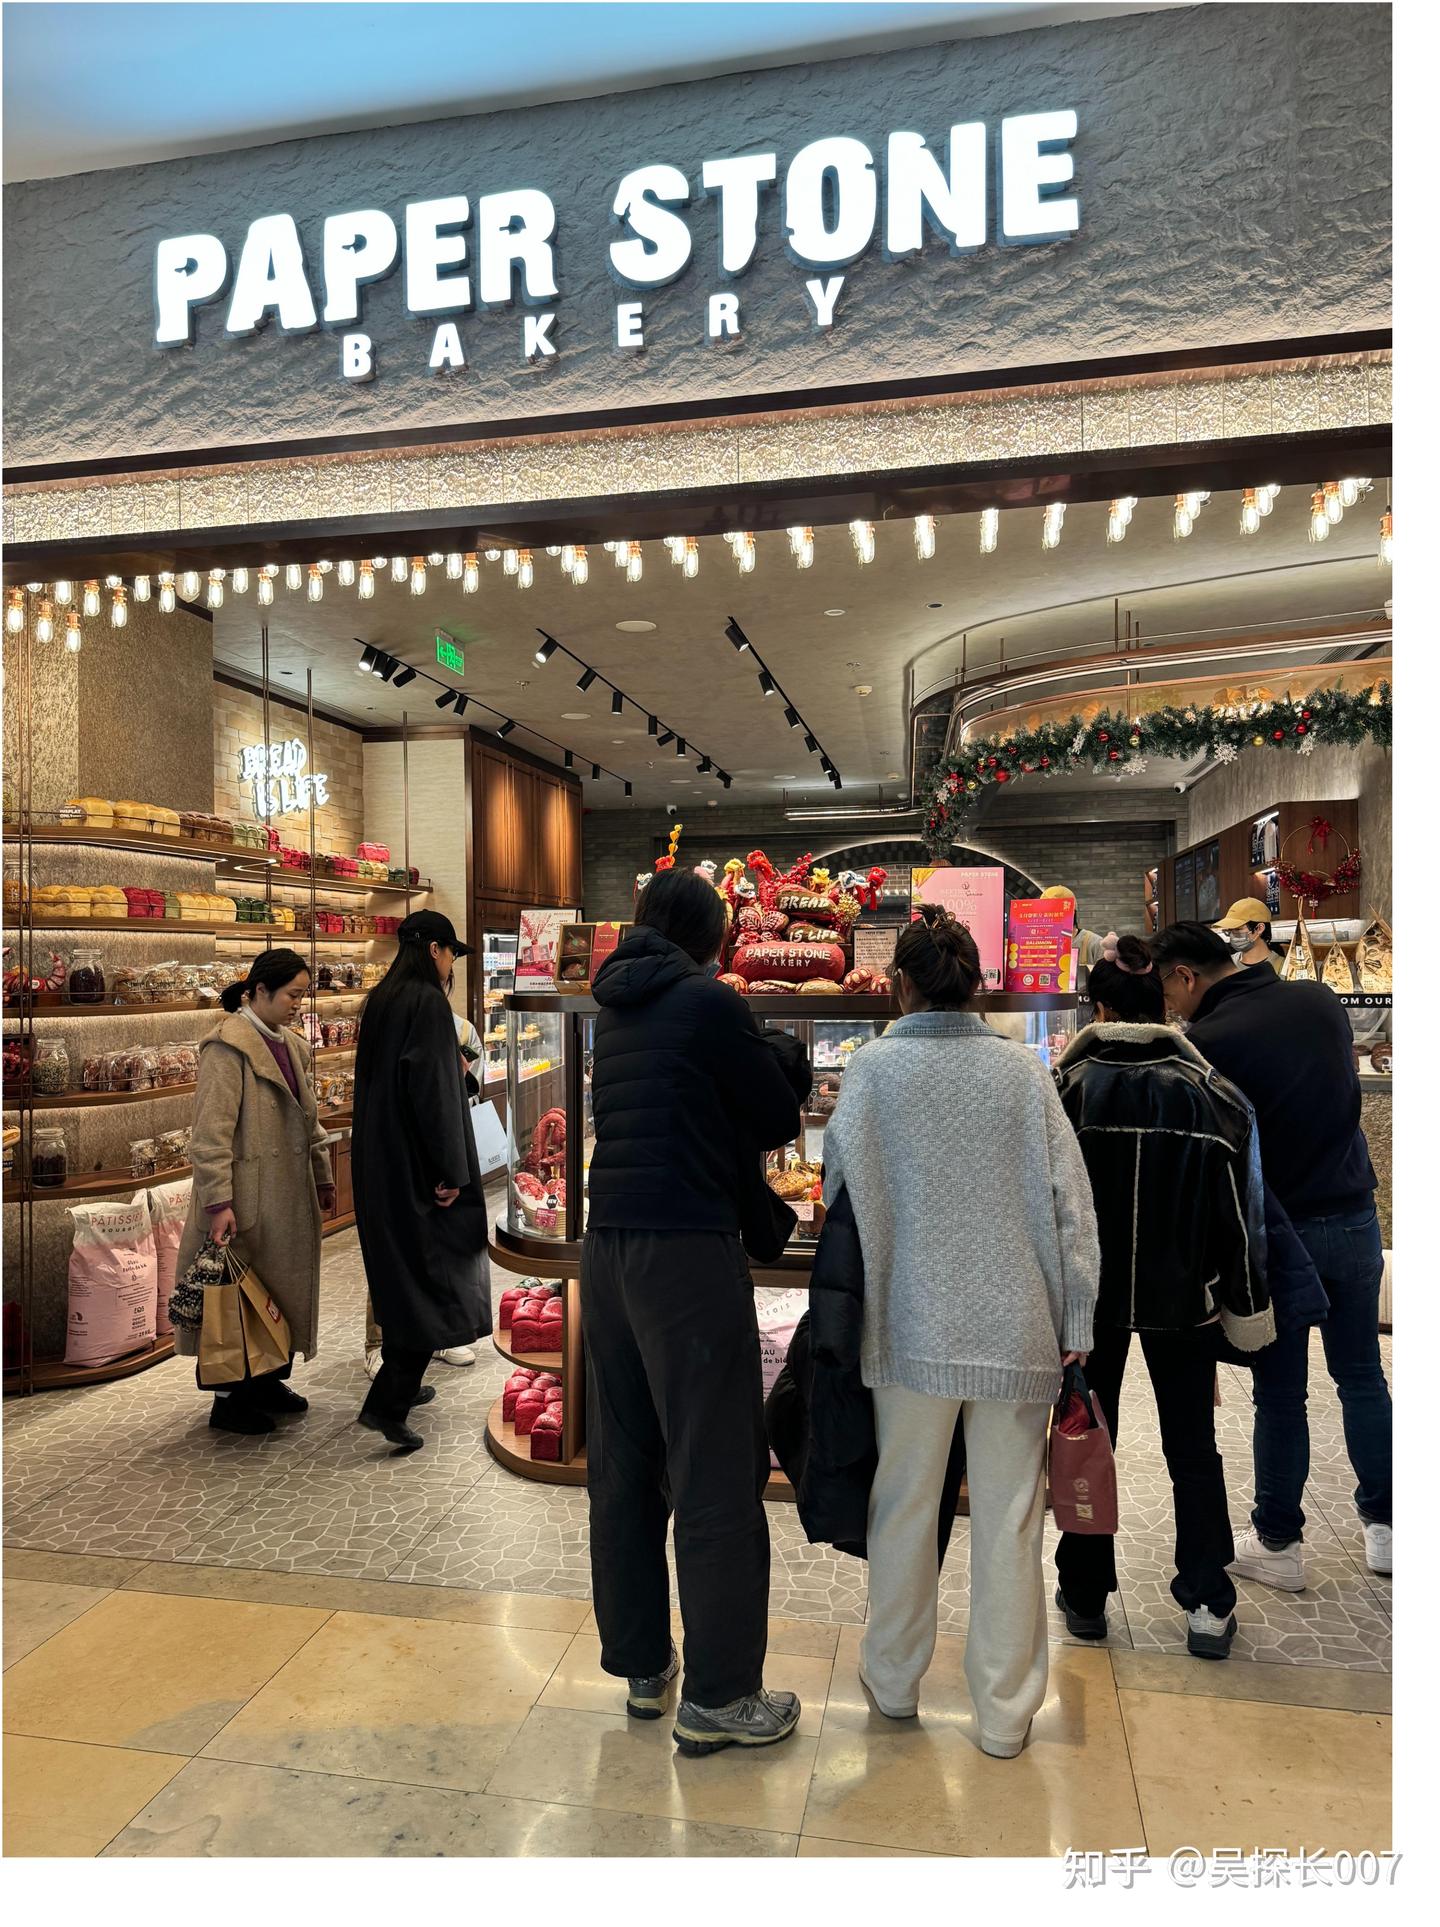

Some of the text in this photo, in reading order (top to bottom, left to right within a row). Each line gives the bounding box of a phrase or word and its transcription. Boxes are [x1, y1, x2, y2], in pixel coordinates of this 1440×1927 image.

[153, 109, 1081, 345] PAPER STONE
[342, 275, 847, 381] BAKERY
[241, 737, 308, 782] BREAD
[281, 773, 330, 812] LIFE
[779, 895, 830, 911] BREAD
[789, 930, 841, 943] IS LIFE
[745, 947, 832, 961] PAPER STONE
[762, 958, 812, 968] BAKERY
[1364, 997, 1392, 1005] OUR
